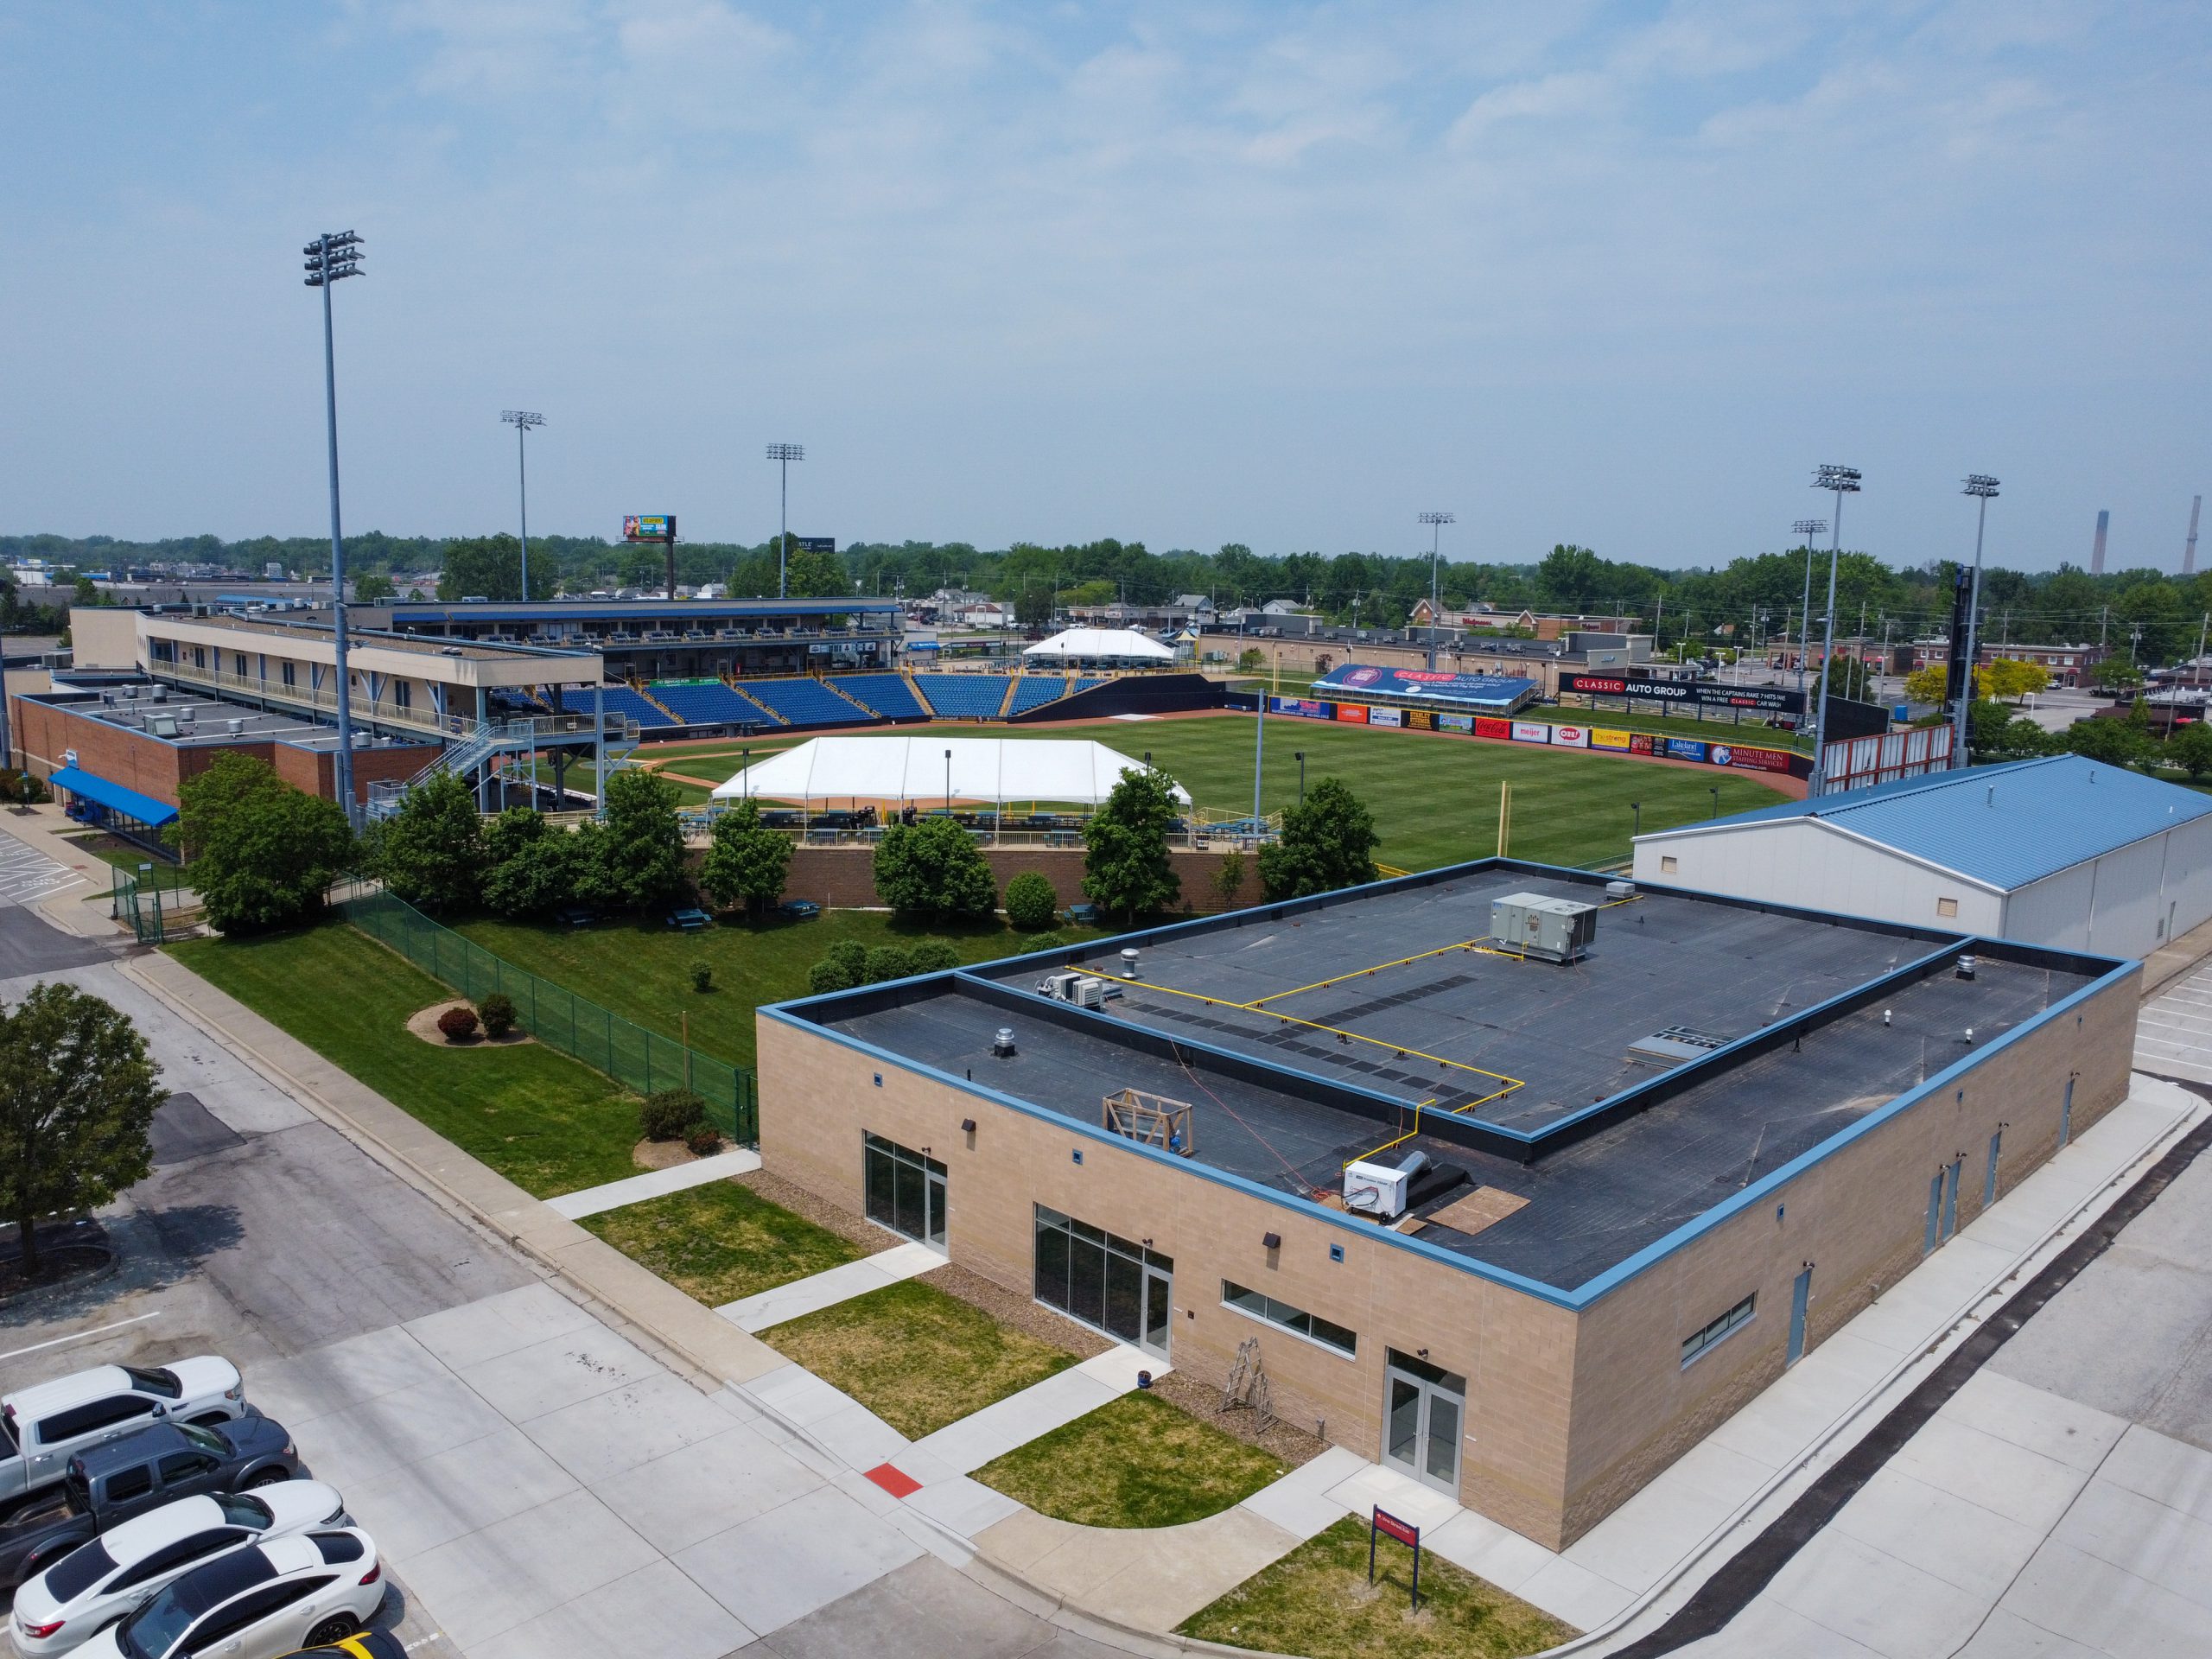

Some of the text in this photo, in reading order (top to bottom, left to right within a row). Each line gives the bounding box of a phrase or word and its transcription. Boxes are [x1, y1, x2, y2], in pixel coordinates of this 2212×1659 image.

[1398, 671, 1452, 679] CLASSIC
[1576, 680, 1687, 696] CLASSIC AUTO GROUP
[1520, 728, 1541, 737] meijer
[1560, 729, 1579, 738] OH!
[1672, 739, 1697, 750] Lakeland
[1732, 748, 1764, 759] MINUTE
